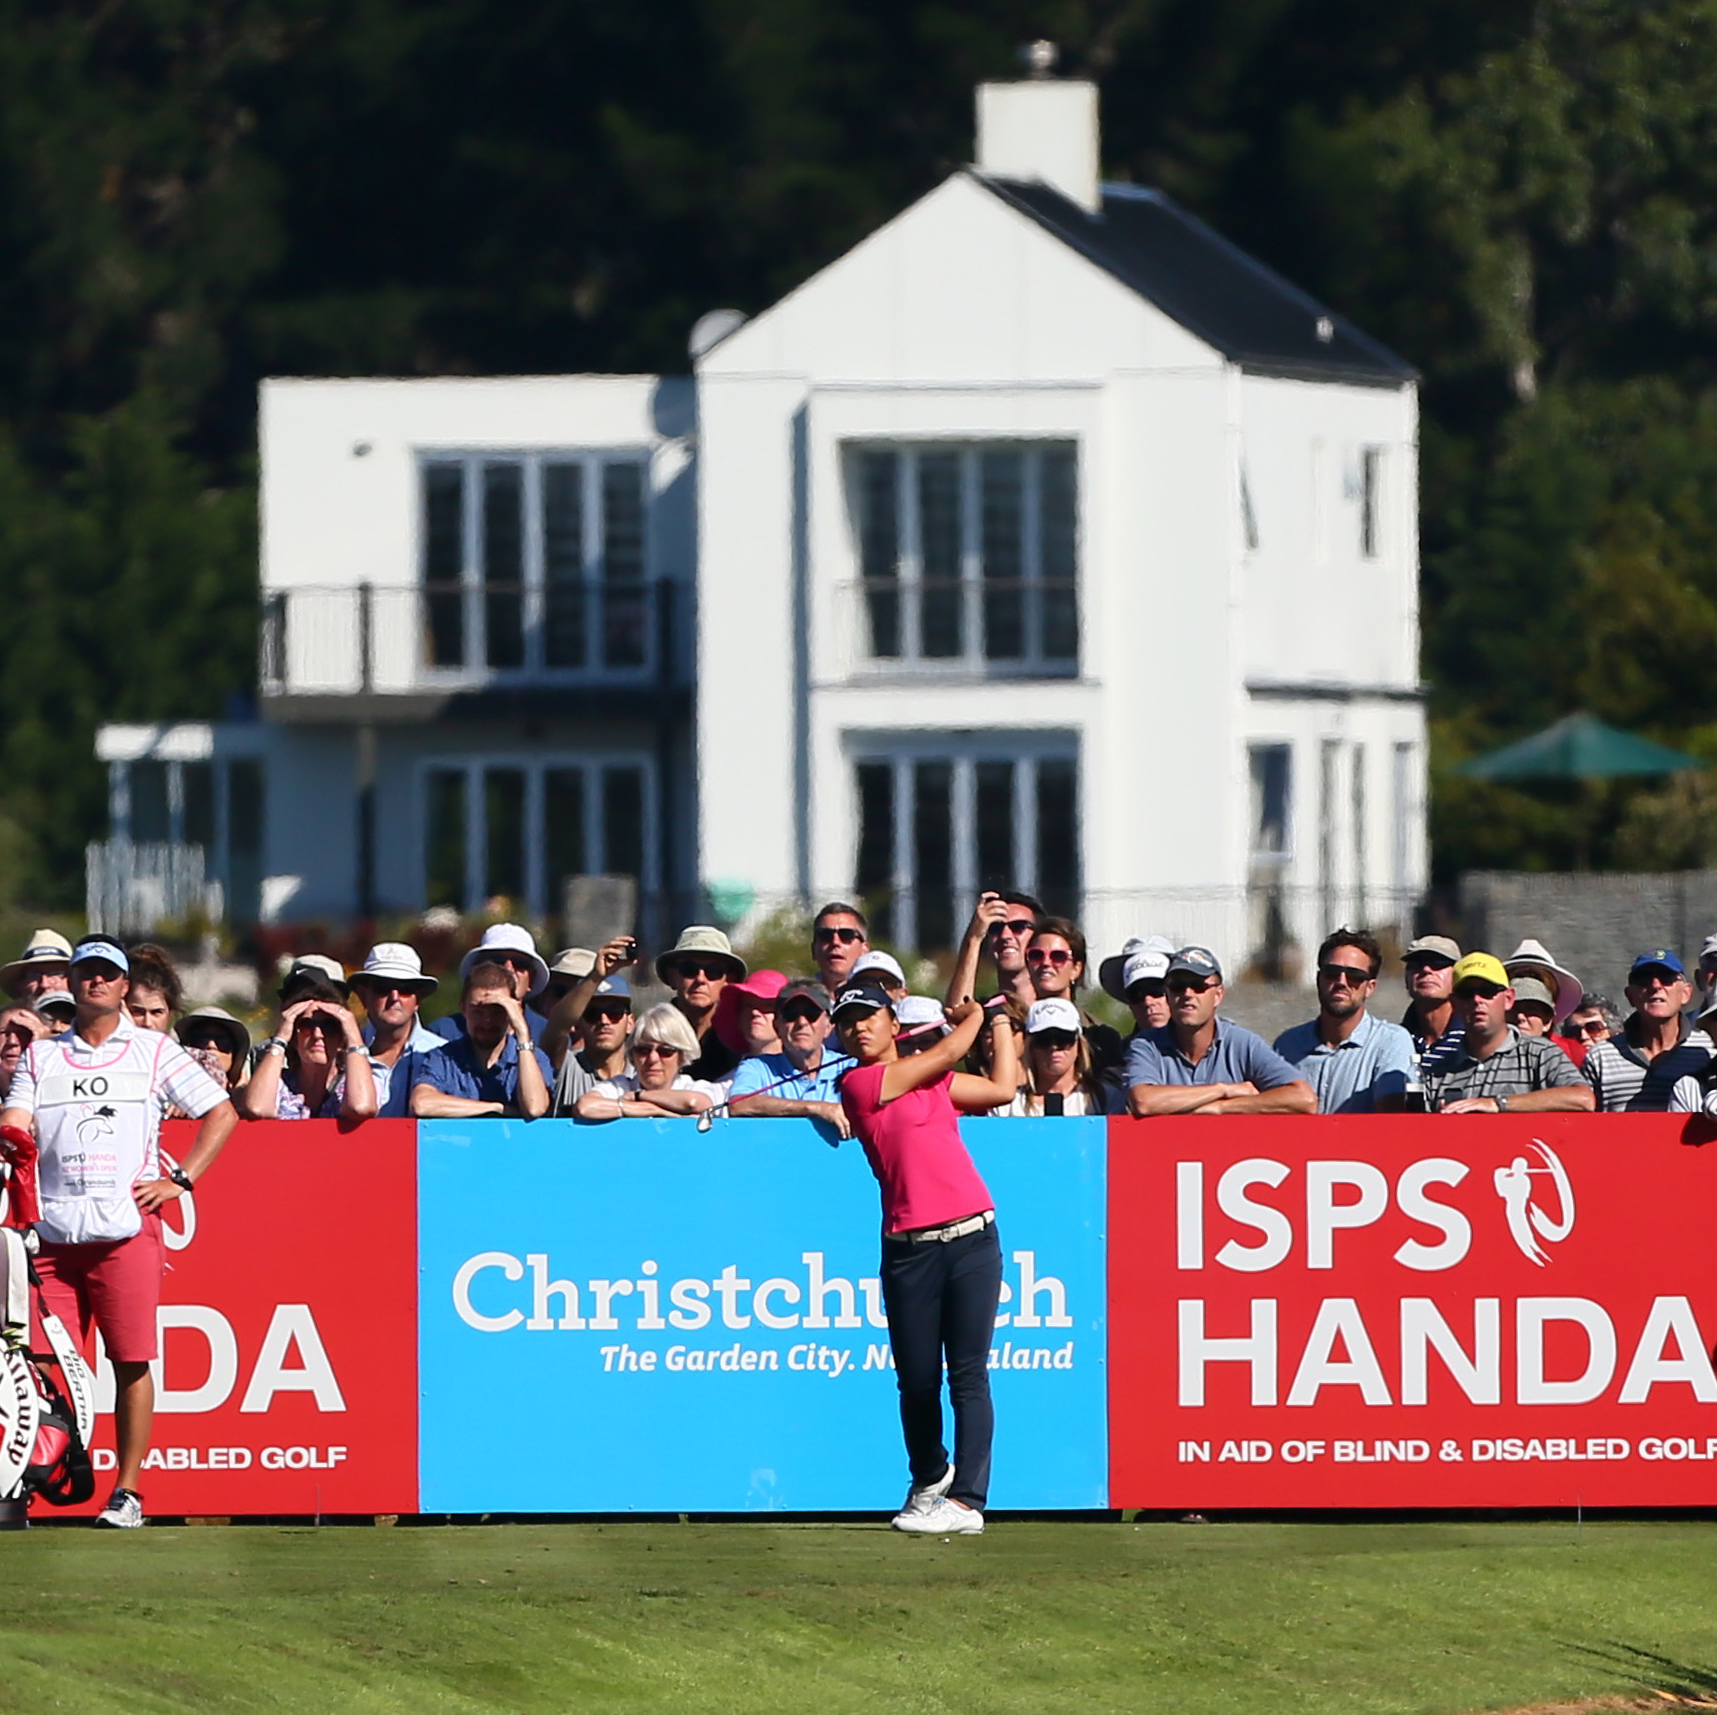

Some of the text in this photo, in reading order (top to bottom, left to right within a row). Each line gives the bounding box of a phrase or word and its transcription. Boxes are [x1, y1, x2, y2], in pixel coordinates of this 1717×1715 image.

[73, 1077, 109, 1097] KO
[1176, 1158, 1472, 1272] ISPS
[452, 1251, 1074, 1333] Christchh
[599, 1343, 658, 1372] The
[664, 1343, 780, 1372] Garden
[787, 1343, 856, 1378] City.
[92, 1446, 348, 1471] DABLED GOLF
[1178, 1441, 1211, 1463] IN
[1218, 1440, 1273, 1462] AID
[1280, 1440, 1326, 1463] OF
[1333, 1440, 1431, 1462] BLIND
[1438, 1439, 1464, 1462] &
[1472, 1438, 1631, 1462] DISABLED
